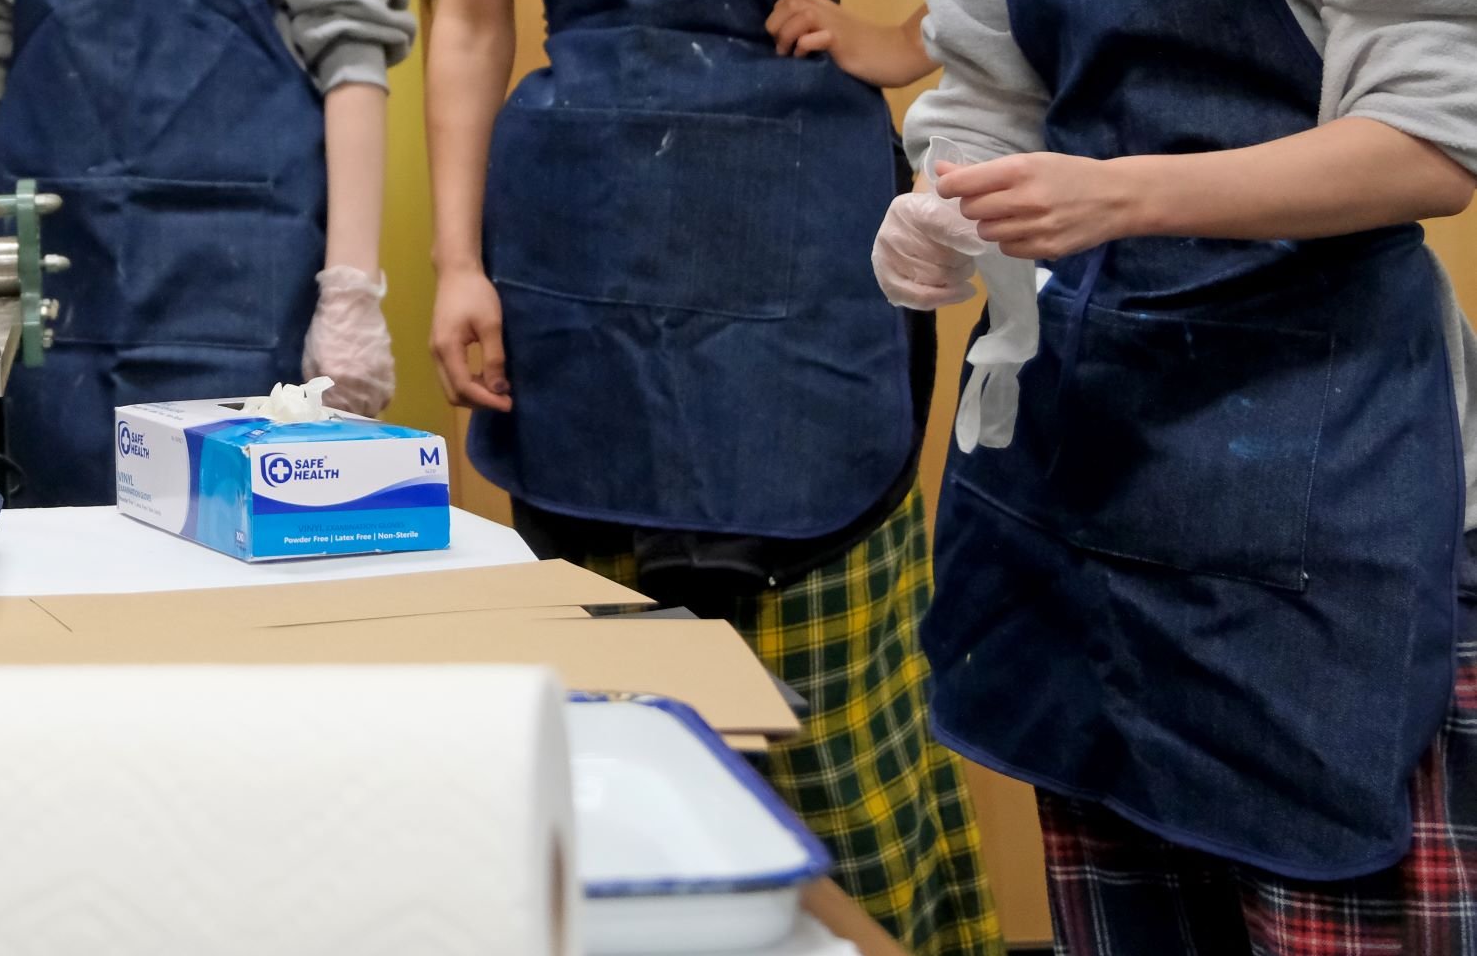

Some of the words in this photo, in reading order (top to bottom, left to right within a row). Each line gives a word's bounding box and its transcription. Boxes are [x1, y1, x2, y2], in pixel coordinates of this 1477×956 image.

[131, 432, 144, 446] SAFE
[130, 445, 150, 459] HEALTH
[419, 447, 440, 466] M
[294, 458, 324, 469] SAFE
[293, 469, 339, 481] HEALTH
[298, 524, 323, 533] VINYL
[326, 523, 377, 532] EXAMINATION
[283, 536, 311, 544] Powder
[313, 535, 329, 543] Free
[377, 531, 419, 540] Non-Sterile
